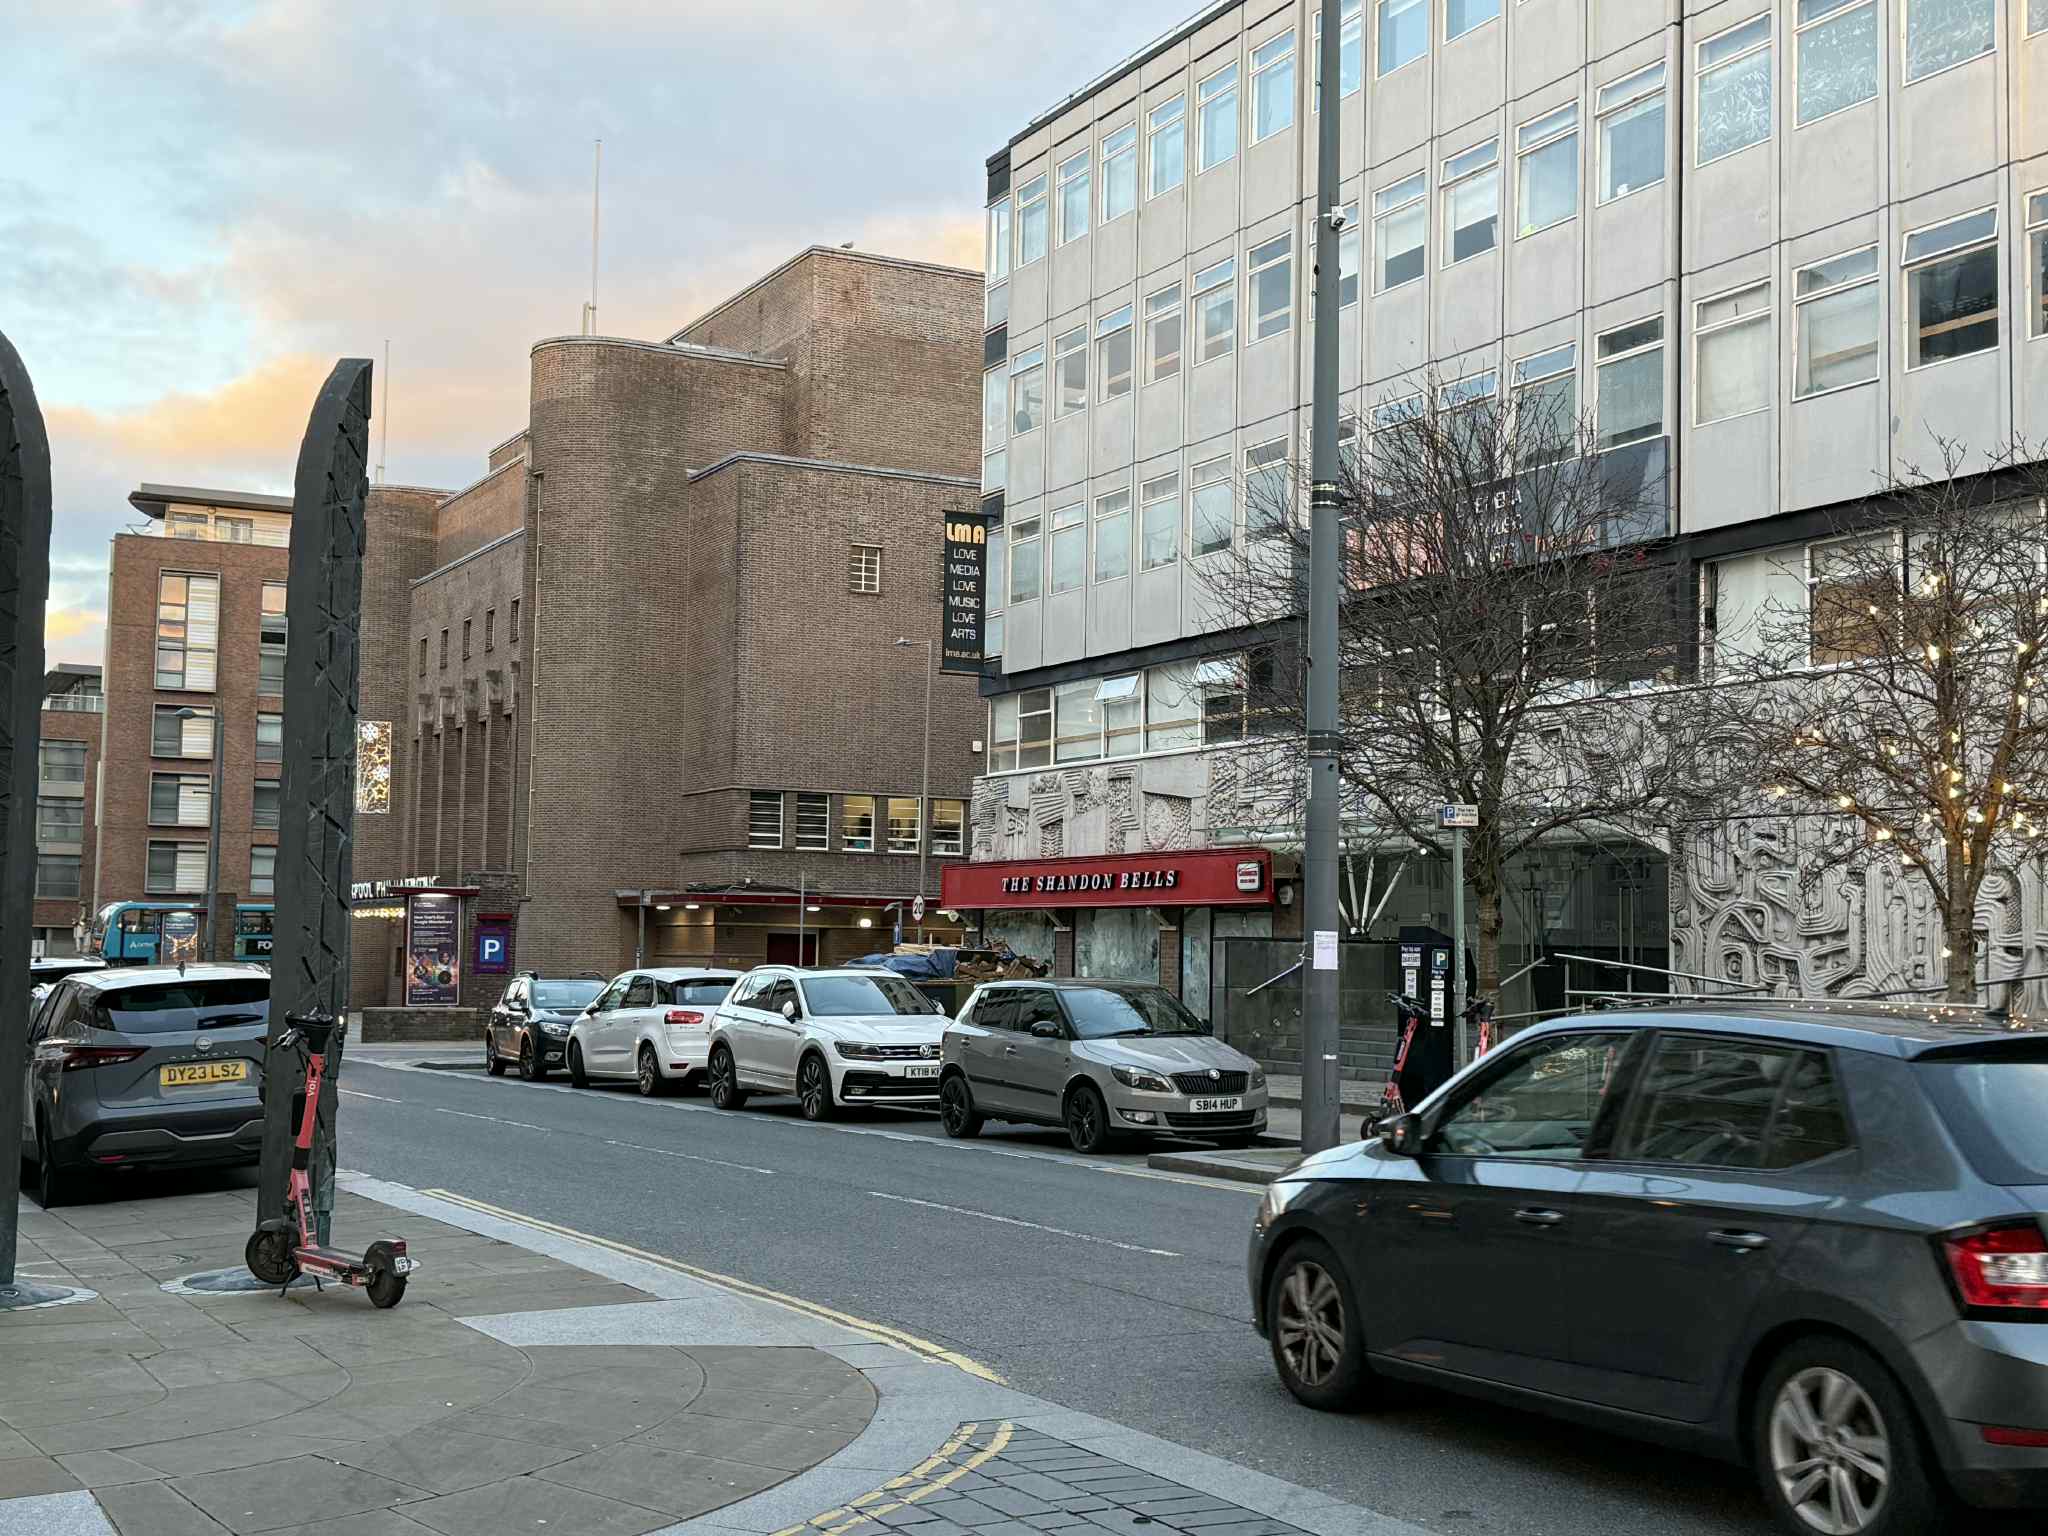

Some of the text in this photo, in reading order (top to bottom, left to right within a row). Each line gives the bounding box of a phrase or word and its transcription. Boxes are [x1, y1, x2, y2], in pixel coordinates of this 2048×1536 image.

[946, 522, 985, 544] LMA
[953, 548, 977, 560] LOVE
[950, 563, 980, 576] MEDIA
[952, 580, 977, 592] LOVE
[948, 596, 980, 609] MUSIC
[952, 613, 976, 625] LOVE
[950, 628, 976, 640] ARTS
[945, 648, 981, 659] lma.ac.uk
[1001, 870, 1176, 892] THE SHANDON BELLS
[913, 902, 923, 915] 20
[484, 939, 500, 960] P
[1436, 952, 1446, 966] P
[167, 1063, 241, 1082] DY23 LSZ
[1220, 1098, 1238, 1110] HUP
